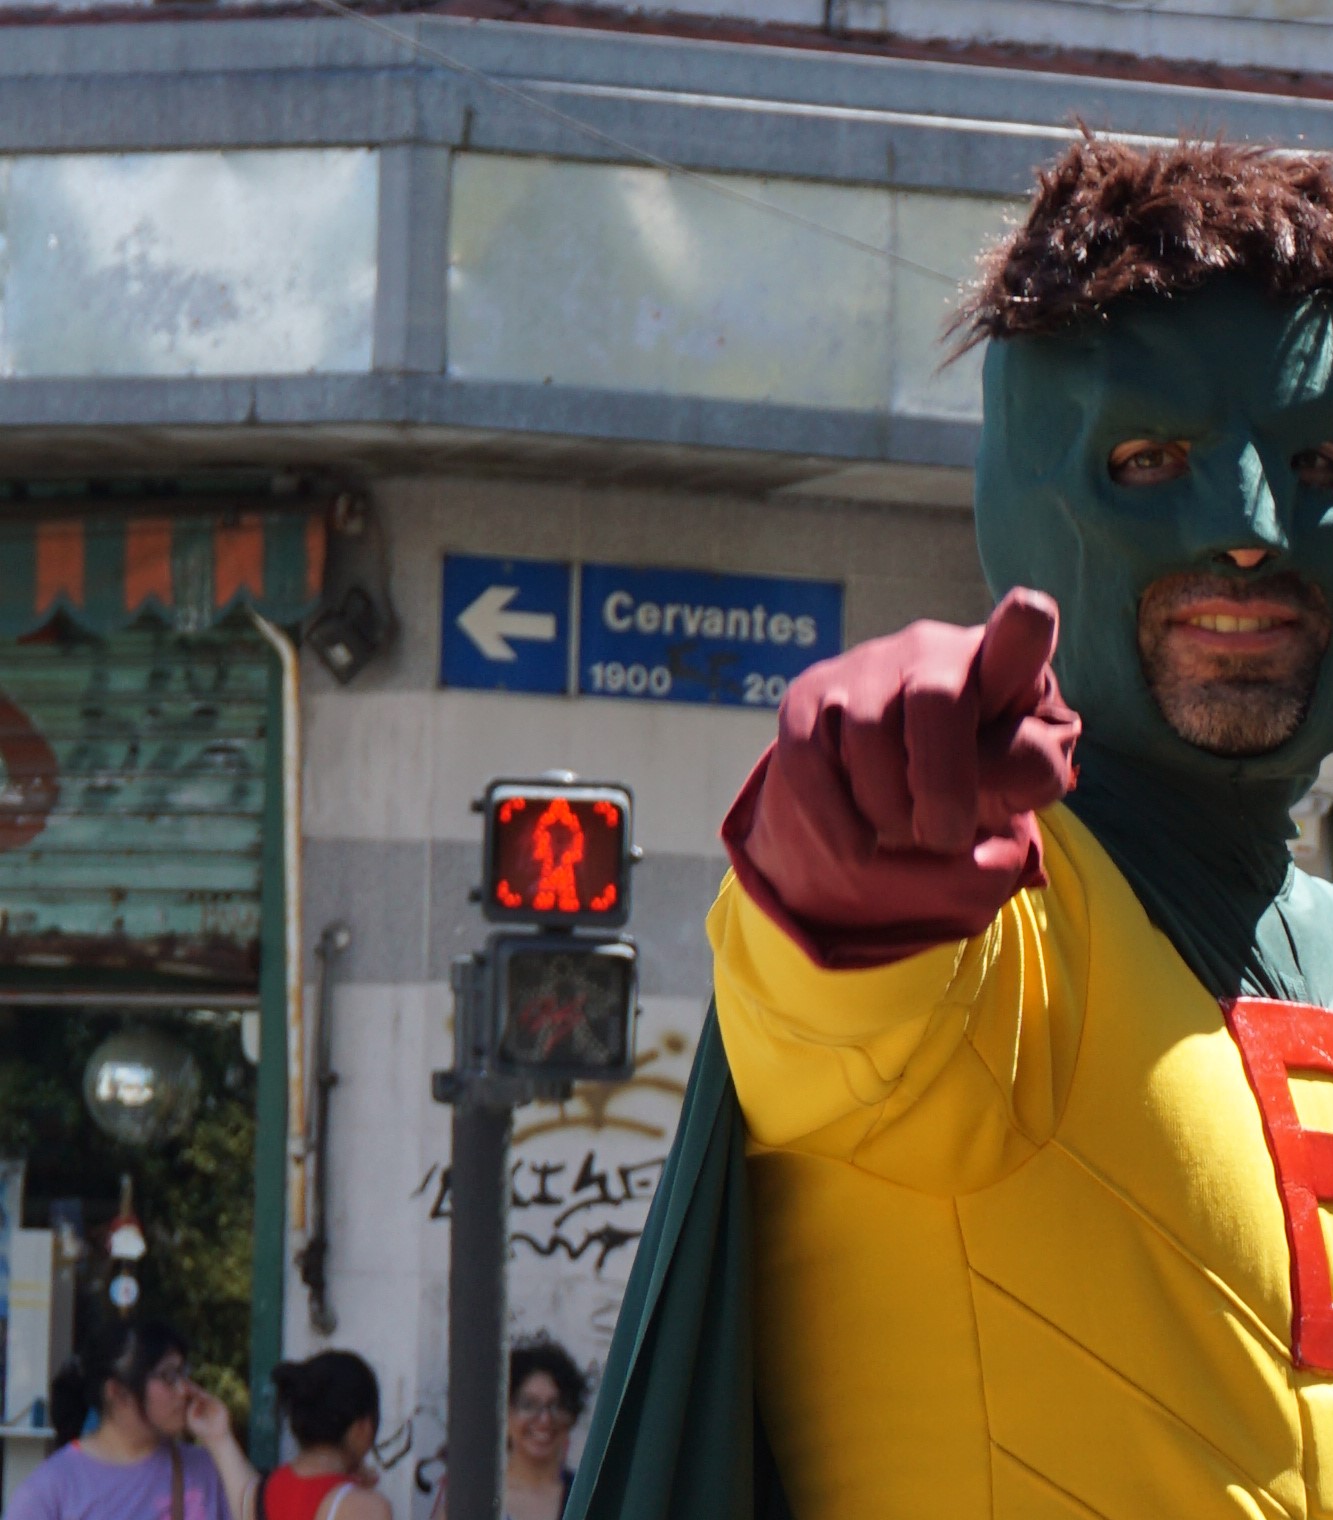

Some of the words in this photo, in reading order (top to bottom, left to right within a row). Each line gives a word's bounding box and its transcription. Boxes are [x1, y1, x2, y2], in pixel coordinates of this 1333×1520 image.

[603, 590, 817, 646] Cervantes
[590, 662, 672, 696] 1900
[743, 672, 793, 704] 20
